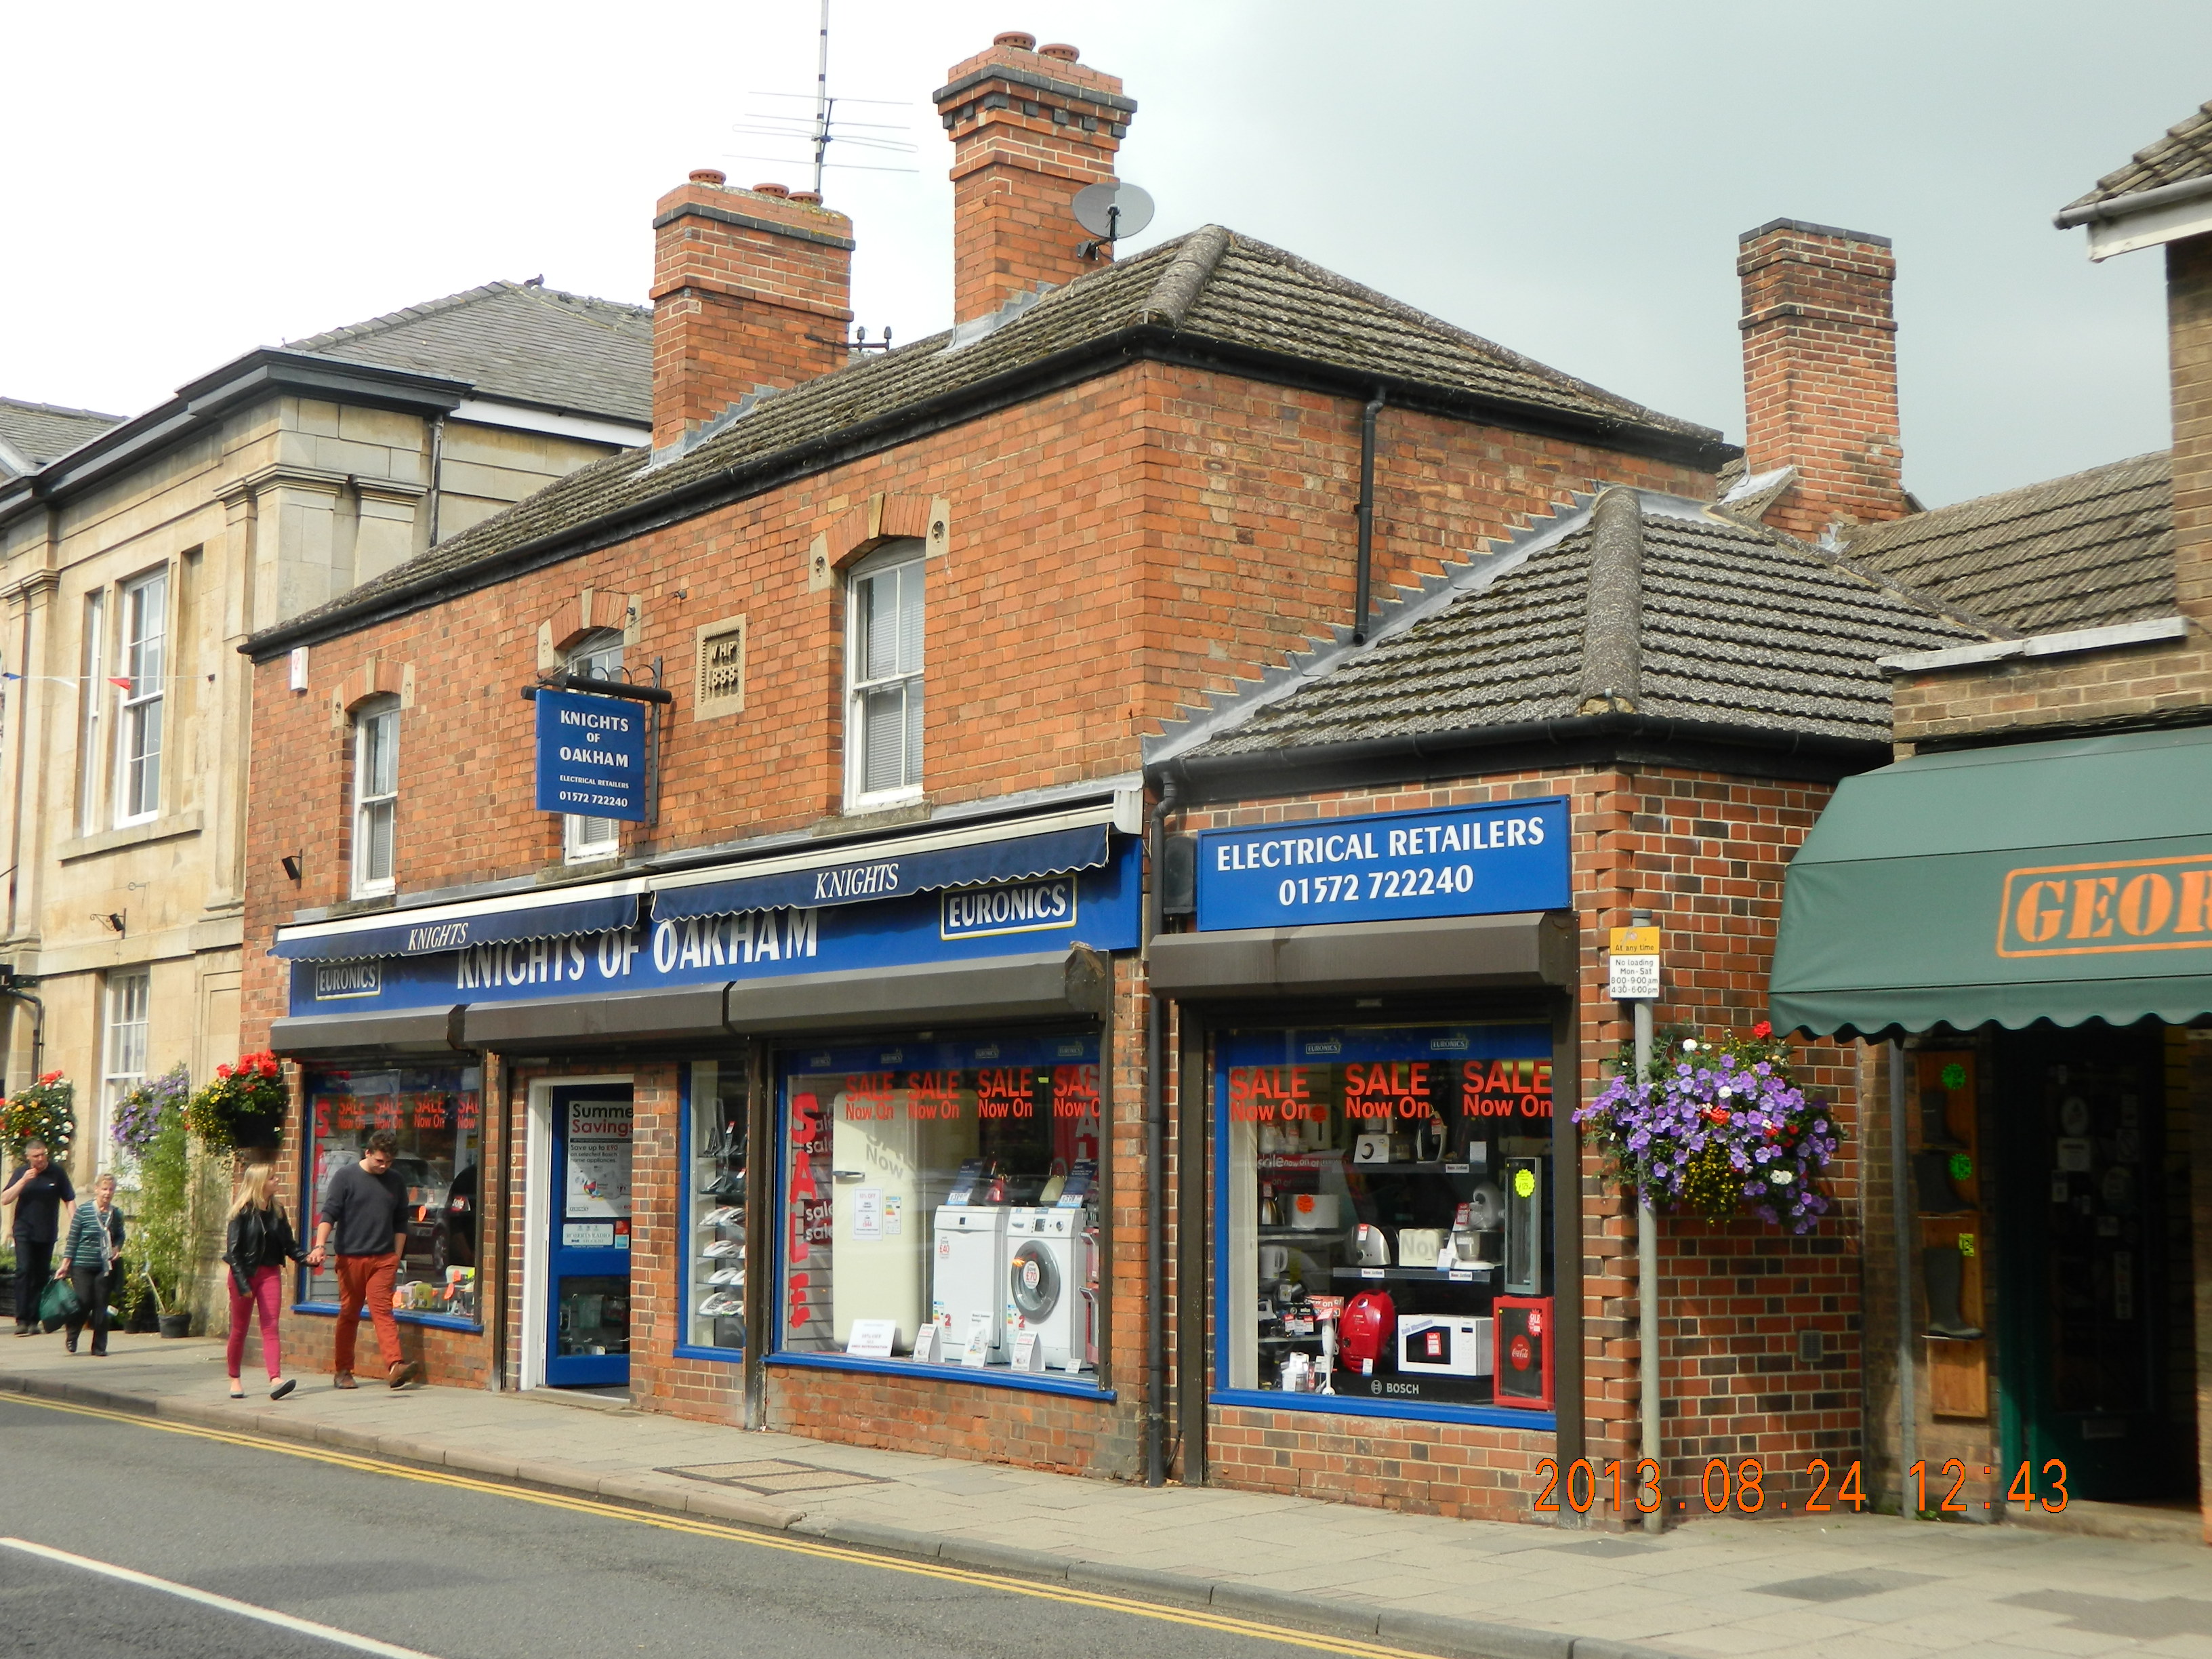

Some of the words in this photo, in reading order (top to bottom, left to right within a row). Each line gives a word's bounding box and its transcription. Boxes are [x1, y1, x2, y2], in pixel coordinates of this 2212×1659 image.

[710, 641, 737, 659] WHP
[560, 710, 629, 732] KNIGHTS
[587, 732, 600, 743] OF
[560, 747, 629, 768] OAKHAM
[560, 775, 596, 785] ELECTRICAL
[598, 779, 629, 789] RETAILERS
[559, 791, 590, 803] 01572
[592, 794, 628, 807] 722240
[1218, 832, 1378, 872] ELECTRICAL
[1389, 816, 1544, 857] RETAILERS
[815, 863, 899, 900] KNIGHTS
[1279, 874, 1359, 906] 01572
[1369, 864, 1474, 899] 722240
[949, 883, 1067, 928] EURONICS
[407, 922, 468, 951] KNIGHTS
[457, 933, 585, 989] KNIGHTS
[598, 925, 640, 979] OF
[654, 907, 818, 973] OAKHAM
[320, 964, 375, 991] EURONICS
[846, 1071, 895, 1101] SALE
[907, 1071, 960, 1100] SALE
[978, 1067, 1033, 1098] SALE
[1229, 1067, 1309, 1101] SALE
[1345, 1063, 1430, 1096] SALE
[1462, 1059, 1553, 1094] SALE
[414, 1092, 445, 1113] SALE
[846, 1103, 873, 1120] Now
[876, 1102, 894, 1120] On
[908, 1102, 937, 1119] Now
[941, 1101, 960, 1118] On
[978, 1099, 1008, 1118] Now
[1013, 1097, 1033, 1118] On
[1054, 1098, 1086, 1117] Now
[1231, 1101, 1275, 1122] Now
[1281, 1099, 1309, 1121] On
[1346, 1097, 1392, 1118] Now
[1399, 1096, 1430, 1118] On
[1464, 1094, 1513, 1117] Now
[1521, 1094, 1553, 1117] On
[414, 1114, 432, 1128] Now
[433, 1113, 445, 1128] On
[806, 1202, 834, 1221] sale
[806, 1223, 834, 1241] sale
[940, 1244, 949, 1252] £40
[1026, 1272, 1037, 1281] £70
[945, 1313, 951, 1326] 2
[1019, 1315, 1025, 1328] 2
[1387, 1382, 1419, 1394] BOSCH
